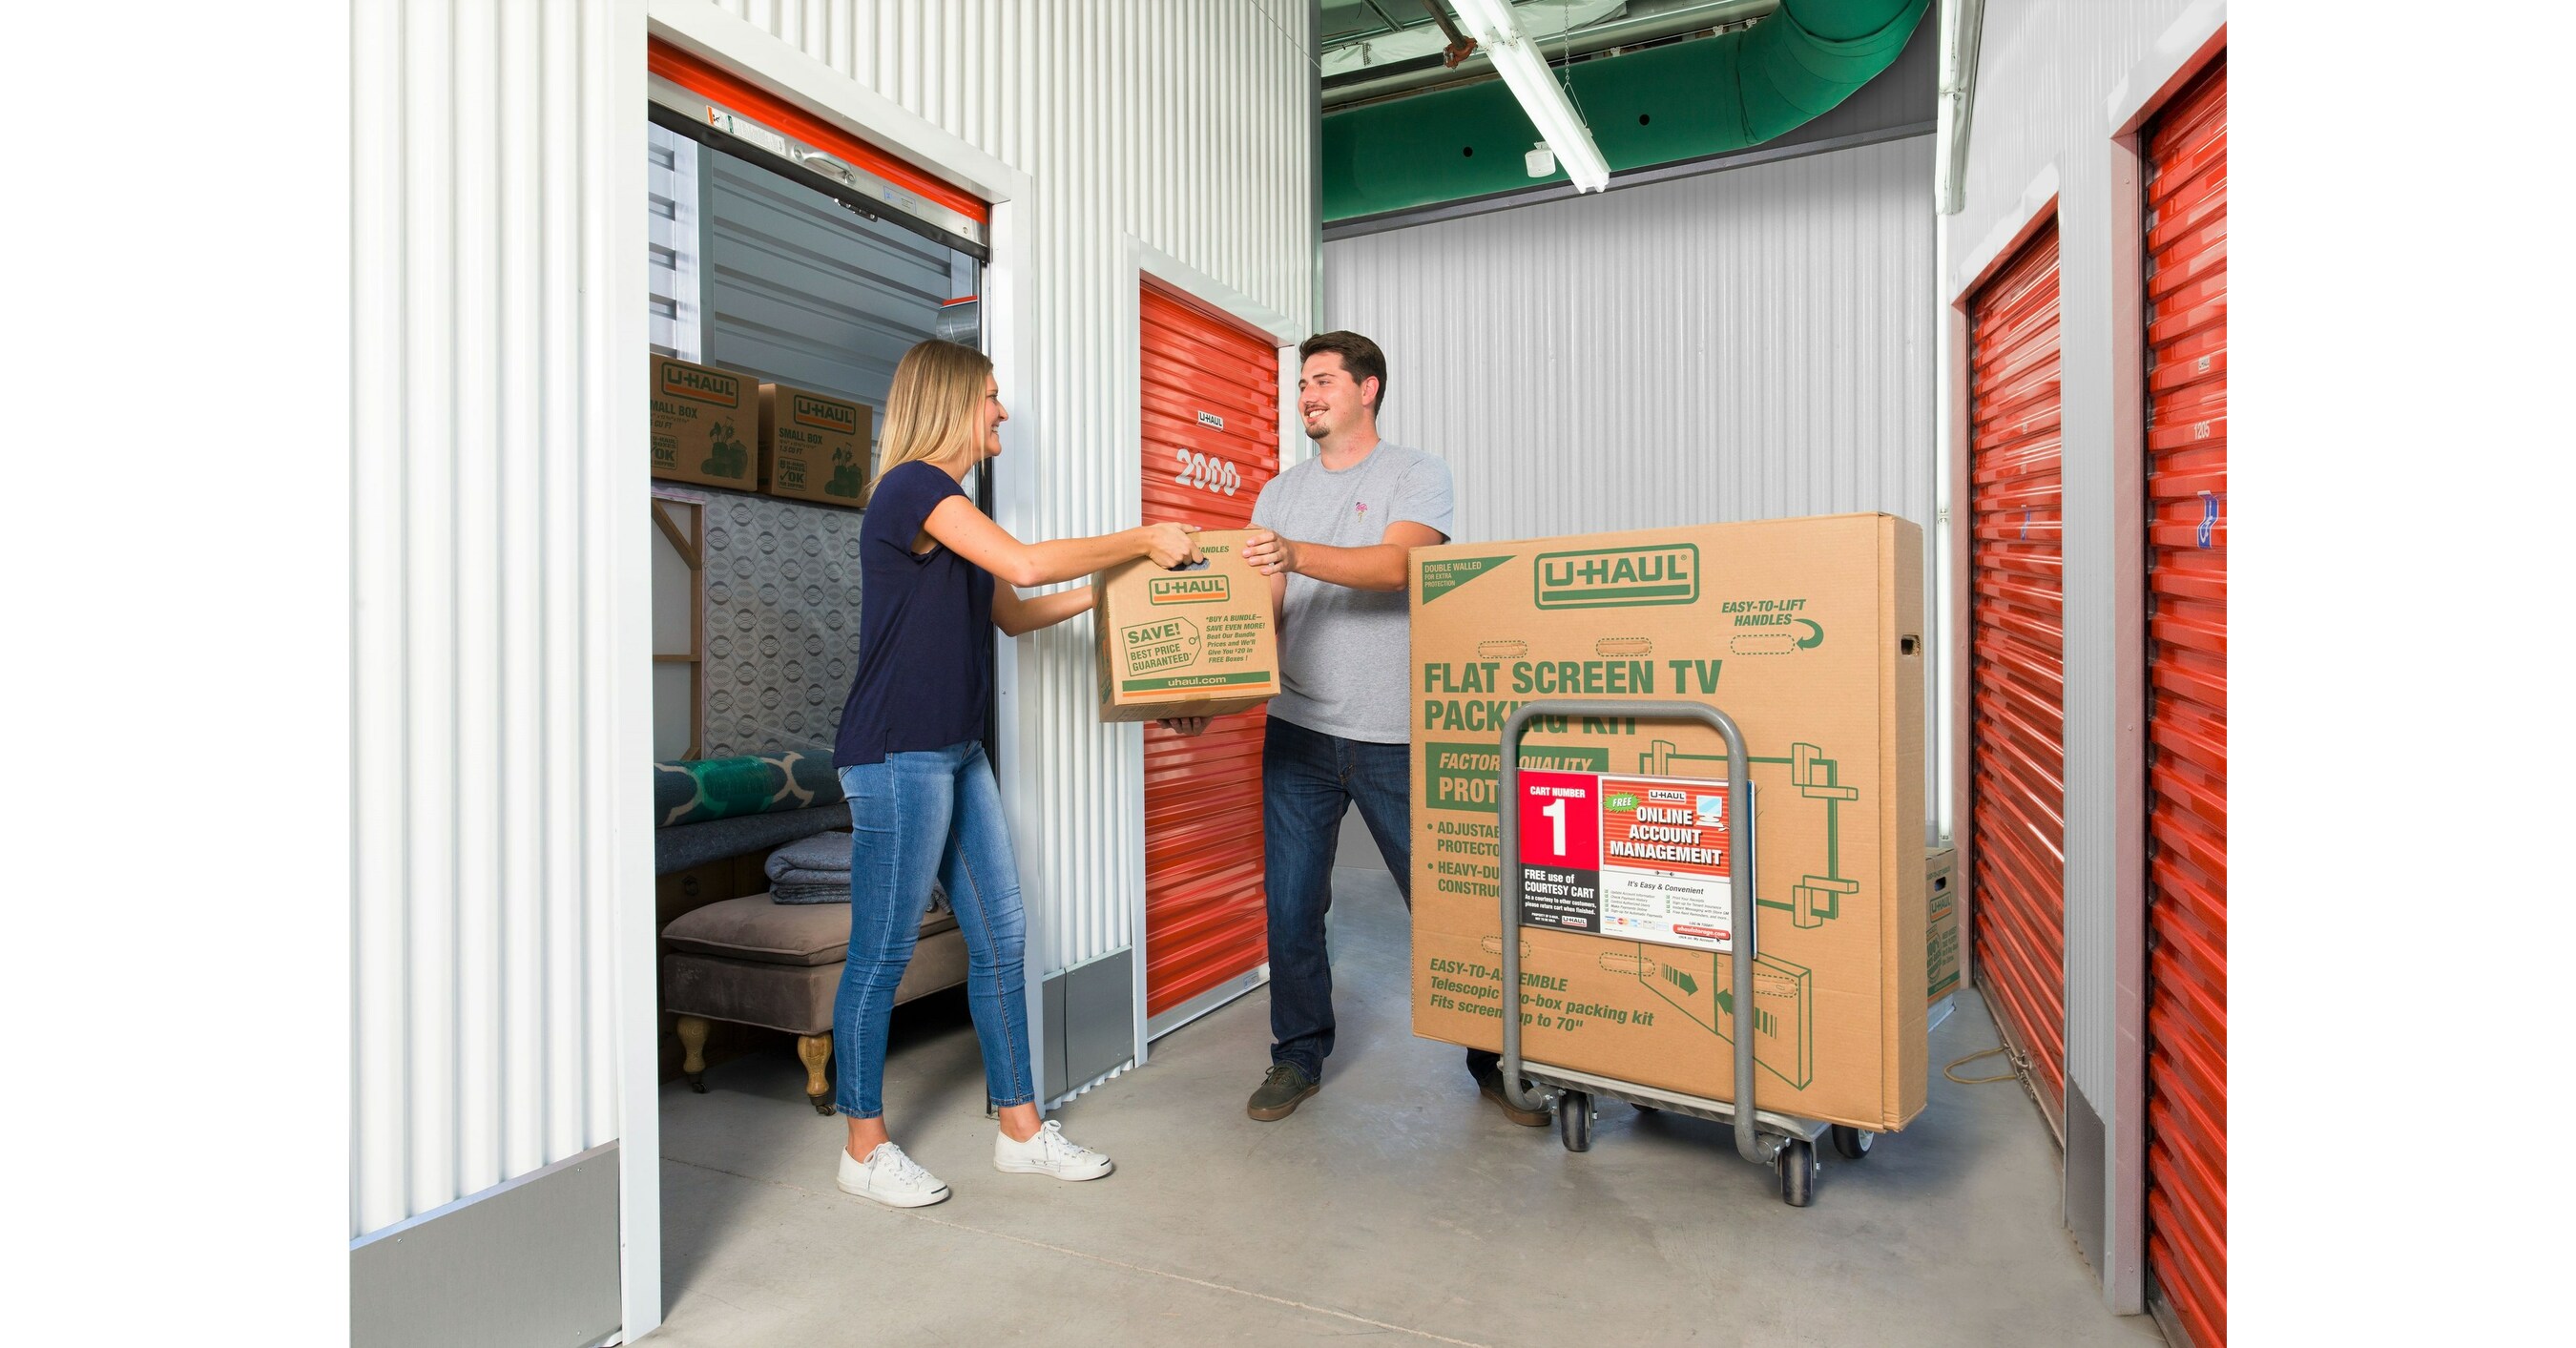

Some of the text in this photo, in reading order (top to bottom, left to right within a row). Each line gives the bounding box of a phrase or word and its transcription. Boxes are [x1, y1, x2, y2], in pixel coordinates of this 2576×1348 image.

[667, 368, 735, 396] U-HAUL
[652, 401, 675, 414] MALL
[678, 404, 697, 419] BOX
[798, 400, 853, 424] U-HAUL
[1199, 411, 1223, 427] U-HAUL
[779, 426, 805, 442] SMALL
[807, 433, 823, 445] BOX
[2194, 421, 2211, 440] 1205
[655, 448, 675, 461] OK
[788, 472, 804, 483] OK
[1174, 447, 1241, 496] 2000
[1424, 561, 1482, 573] DOUBLE WALLED
[1546, 554, 1688, 587] U-HAUL
[1154, 580, 1224, 595] U-HAUL
[1424, 579, 1456, 588] PROTECTION
[1721, 598, 1806, 613] EASY-TO-LIFT
[1734, 612, 1792, 627] HANDLES
[1127, 622, 1181, 644] SAVE!
[1130, 643, 1181, 661] BEST PRICE
[1168, 675, 1227, 687] uhaul.com
[1424, 659, 1723, 695] FLAT SCREEN TV
[1439, 752, 1593, 772] FACTOR QUALITY
[1529, 786, 1586, 798] CART NUMBER
[1650, 791, 1685, 799] U-HAUL
[1612, 797, 1632, 807] FREE
[1636, 806, 1693, 826] ONLINE
[1437, 821, 1500, 840] ADJUSTAB
[1542, 798, 1567, 856] 1
[1629, 824, 1702, 845] ACCOUNT
[1437, 839, 1500, 857] PROTECTO
[1610, 840, 1723, 865] MANAGEMENT
[1438, 861, 1500, 880] HEAVY-DU
[1525, 868, 1575, 884] FREE use of
[1438, 879, 1500, 898] CONSTRU
[1525, 881, 1594, 899] COURTESY CART
[1640, 881, 1655, 890] Easy
[1665, 884, 1704, 895] Convenient
[1676, 926, 1727, 937] uhaulstorage.com
[1429, 958, 1568, 992] EASY-TO-AEMBLE
[1430, 976, 1654, 1027] Telescopic o-box packing kit
[1430, 993, 1454, 1010] Fits
[1458, 1000, 1503, 1019] screen
[1537, 1013, 1551, 1027] to
[1556, 1016, 1584, 1032] 70"
